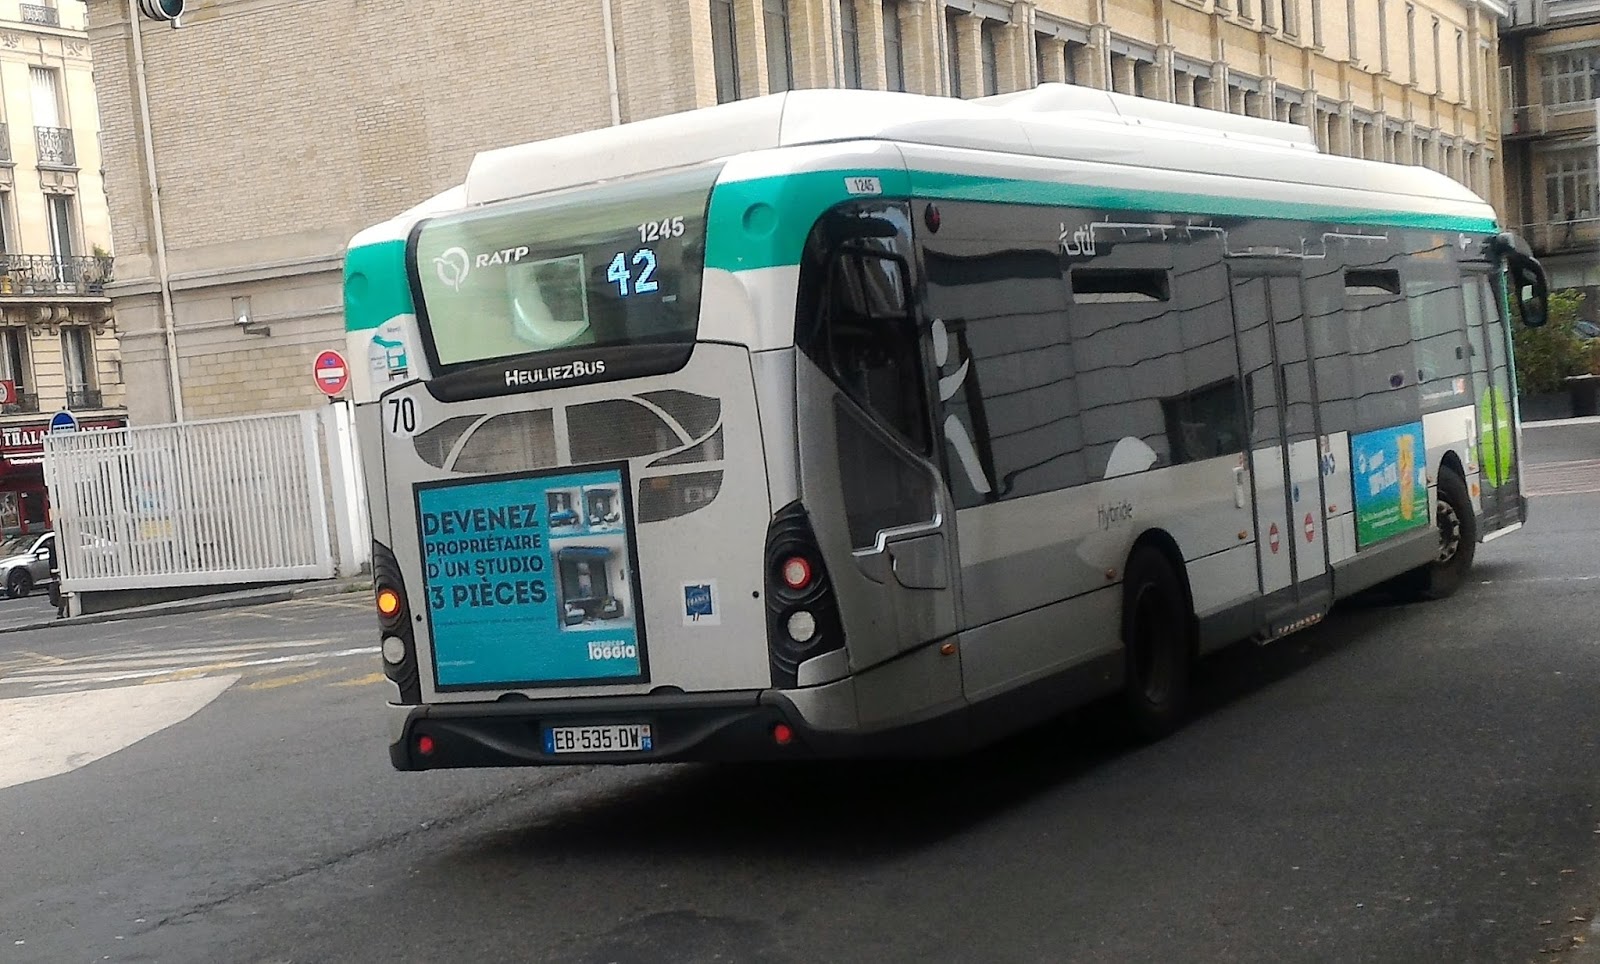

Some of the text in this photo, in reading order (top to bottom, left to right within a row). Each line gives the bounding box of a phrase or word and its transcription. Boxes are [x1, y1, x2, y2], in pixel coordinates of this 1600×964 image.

[854, 179, 875, 192] 1245
[638, 216, 685, 243] 1245
[475, 246, 529, 268] RATP
[606, 248, 658, 296] 42
[388, 397, 416, 433] 70
[423, 503, 539, 536] DEVENEZ
[426, 533, 542, 557] PROPRIÉTAIRE
[427, 554, 544, 579] D'UN STUDIO
[431, 576, 547, 610] 3 PIÈCES
